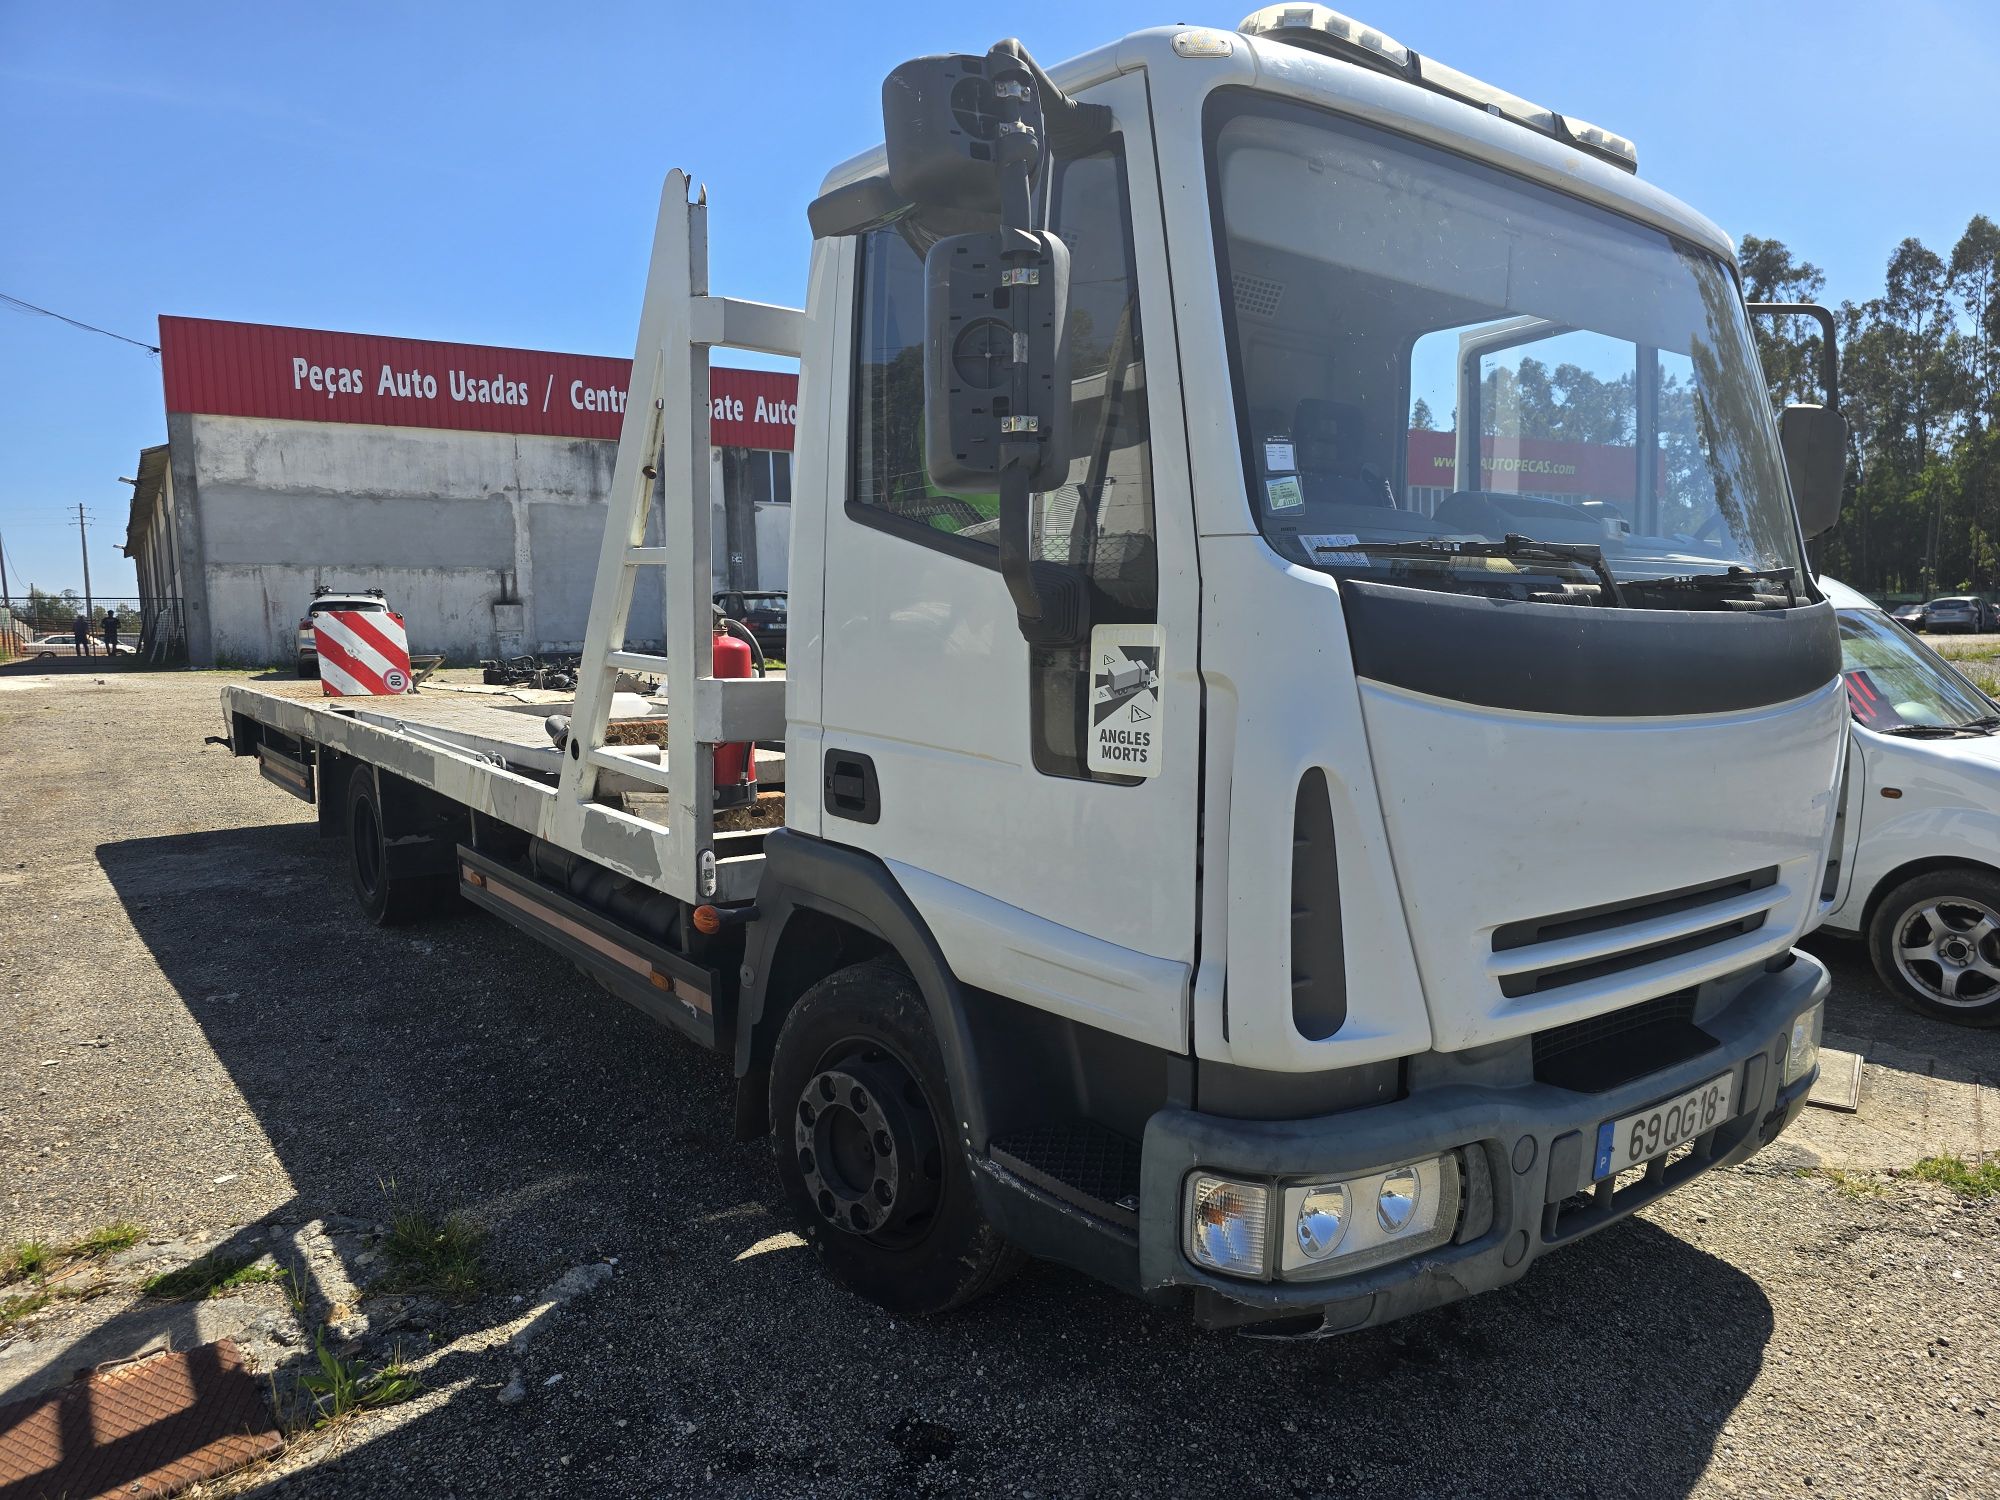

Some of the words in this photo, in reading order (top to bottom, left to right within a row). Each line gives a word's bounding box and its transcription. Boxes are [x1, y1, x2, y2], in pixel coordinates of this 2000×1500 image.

[293, 357, 362, 399] Peças
[377, 364, 438, 400] Auto
[448, 369, 528, 406] Usadas
[542, 373, 554, 413] /
[570, 379, 629, 414] Centr
[390, 675, 401, 686] 80
[1099, 728, 1151, 746] ANGLES
[1101, 745, 1148, 763] MORTS
